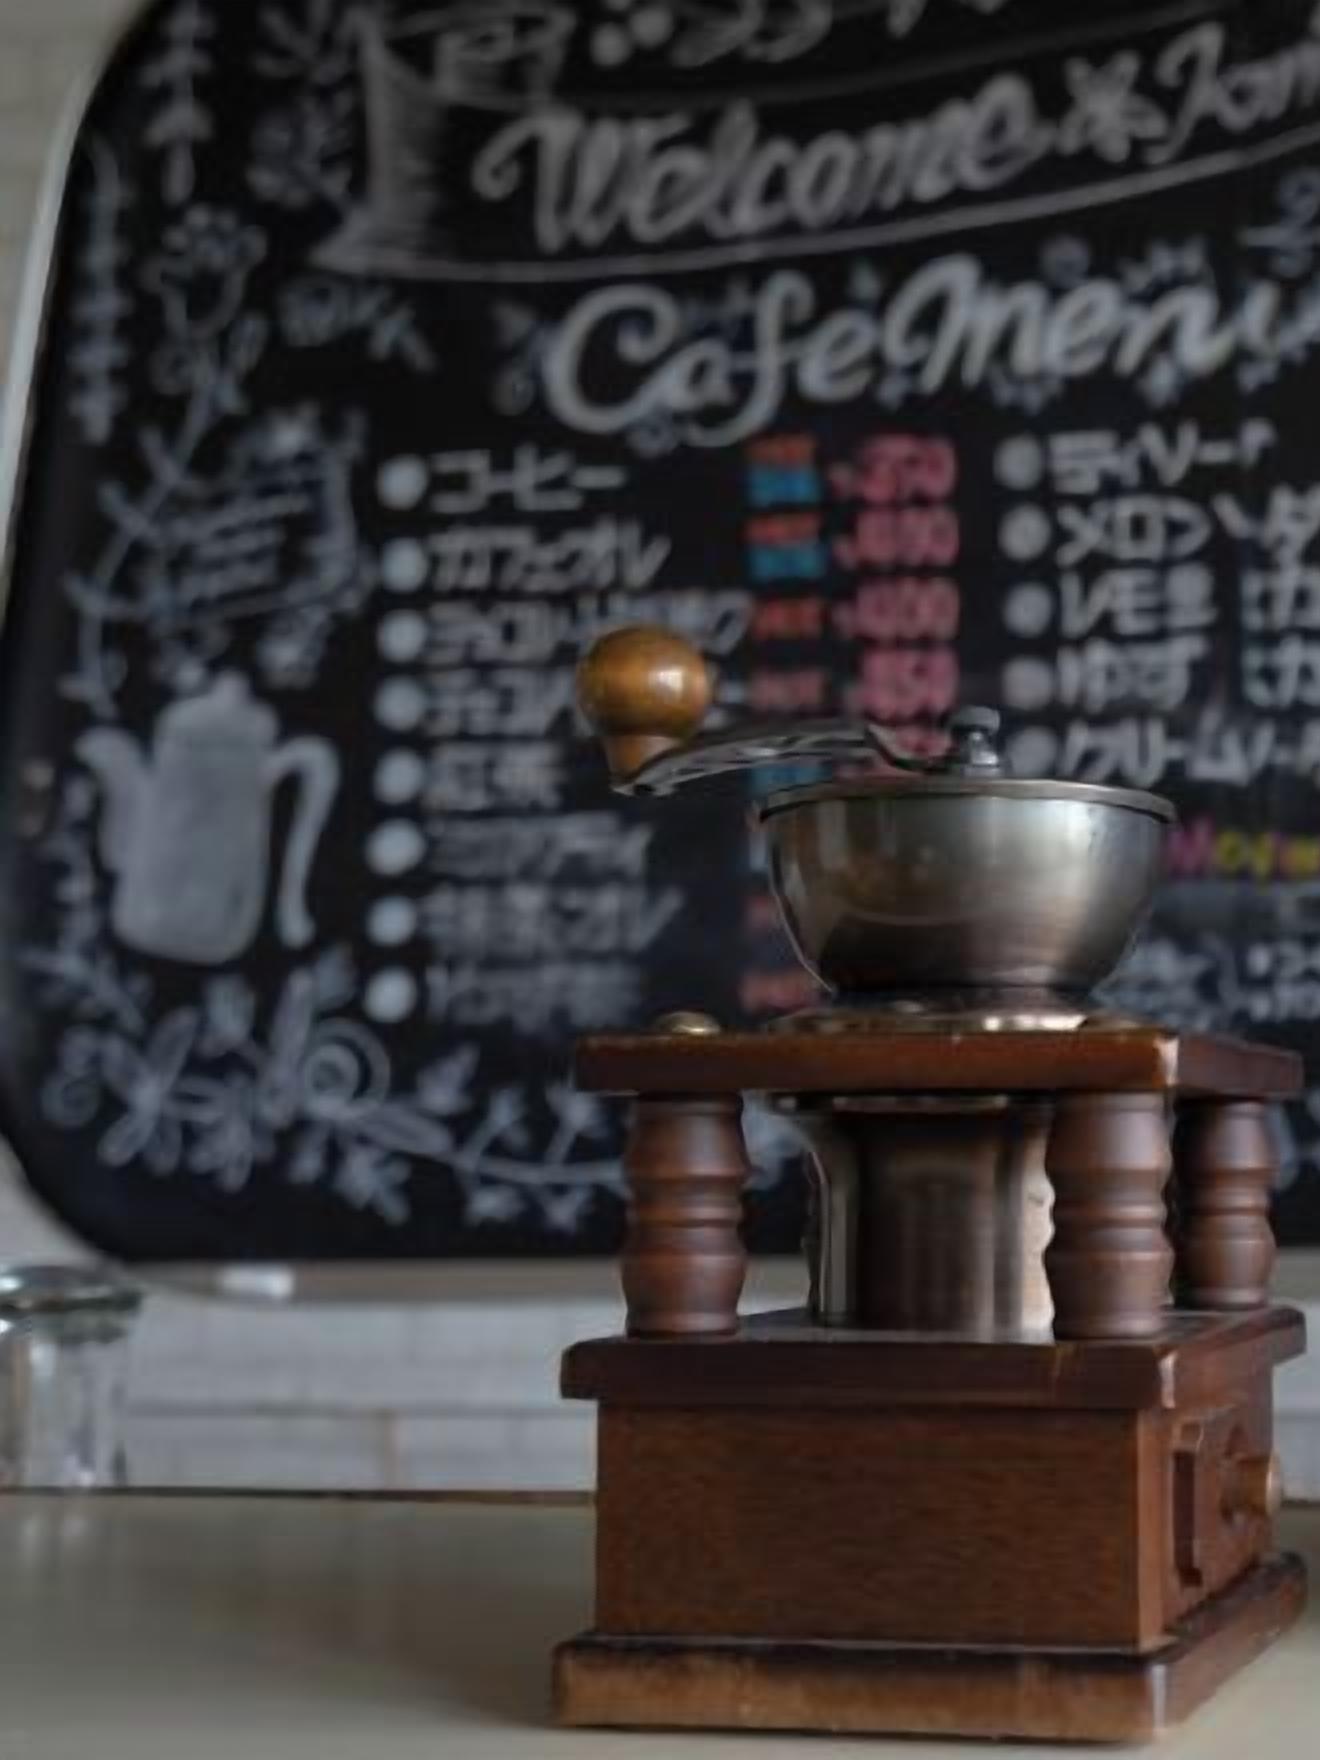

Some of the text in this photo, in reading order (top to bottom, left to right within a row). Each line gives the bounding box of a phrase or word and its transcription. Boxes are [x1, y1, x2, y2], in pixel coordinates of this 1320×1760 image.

[470, 76, 1048, 254] Welcome
[545, 254, 1310, 448] Cafe Menu
[430, 446, 626, 514] コーヒー
[430, 517, 672, 592] カフェオレ
